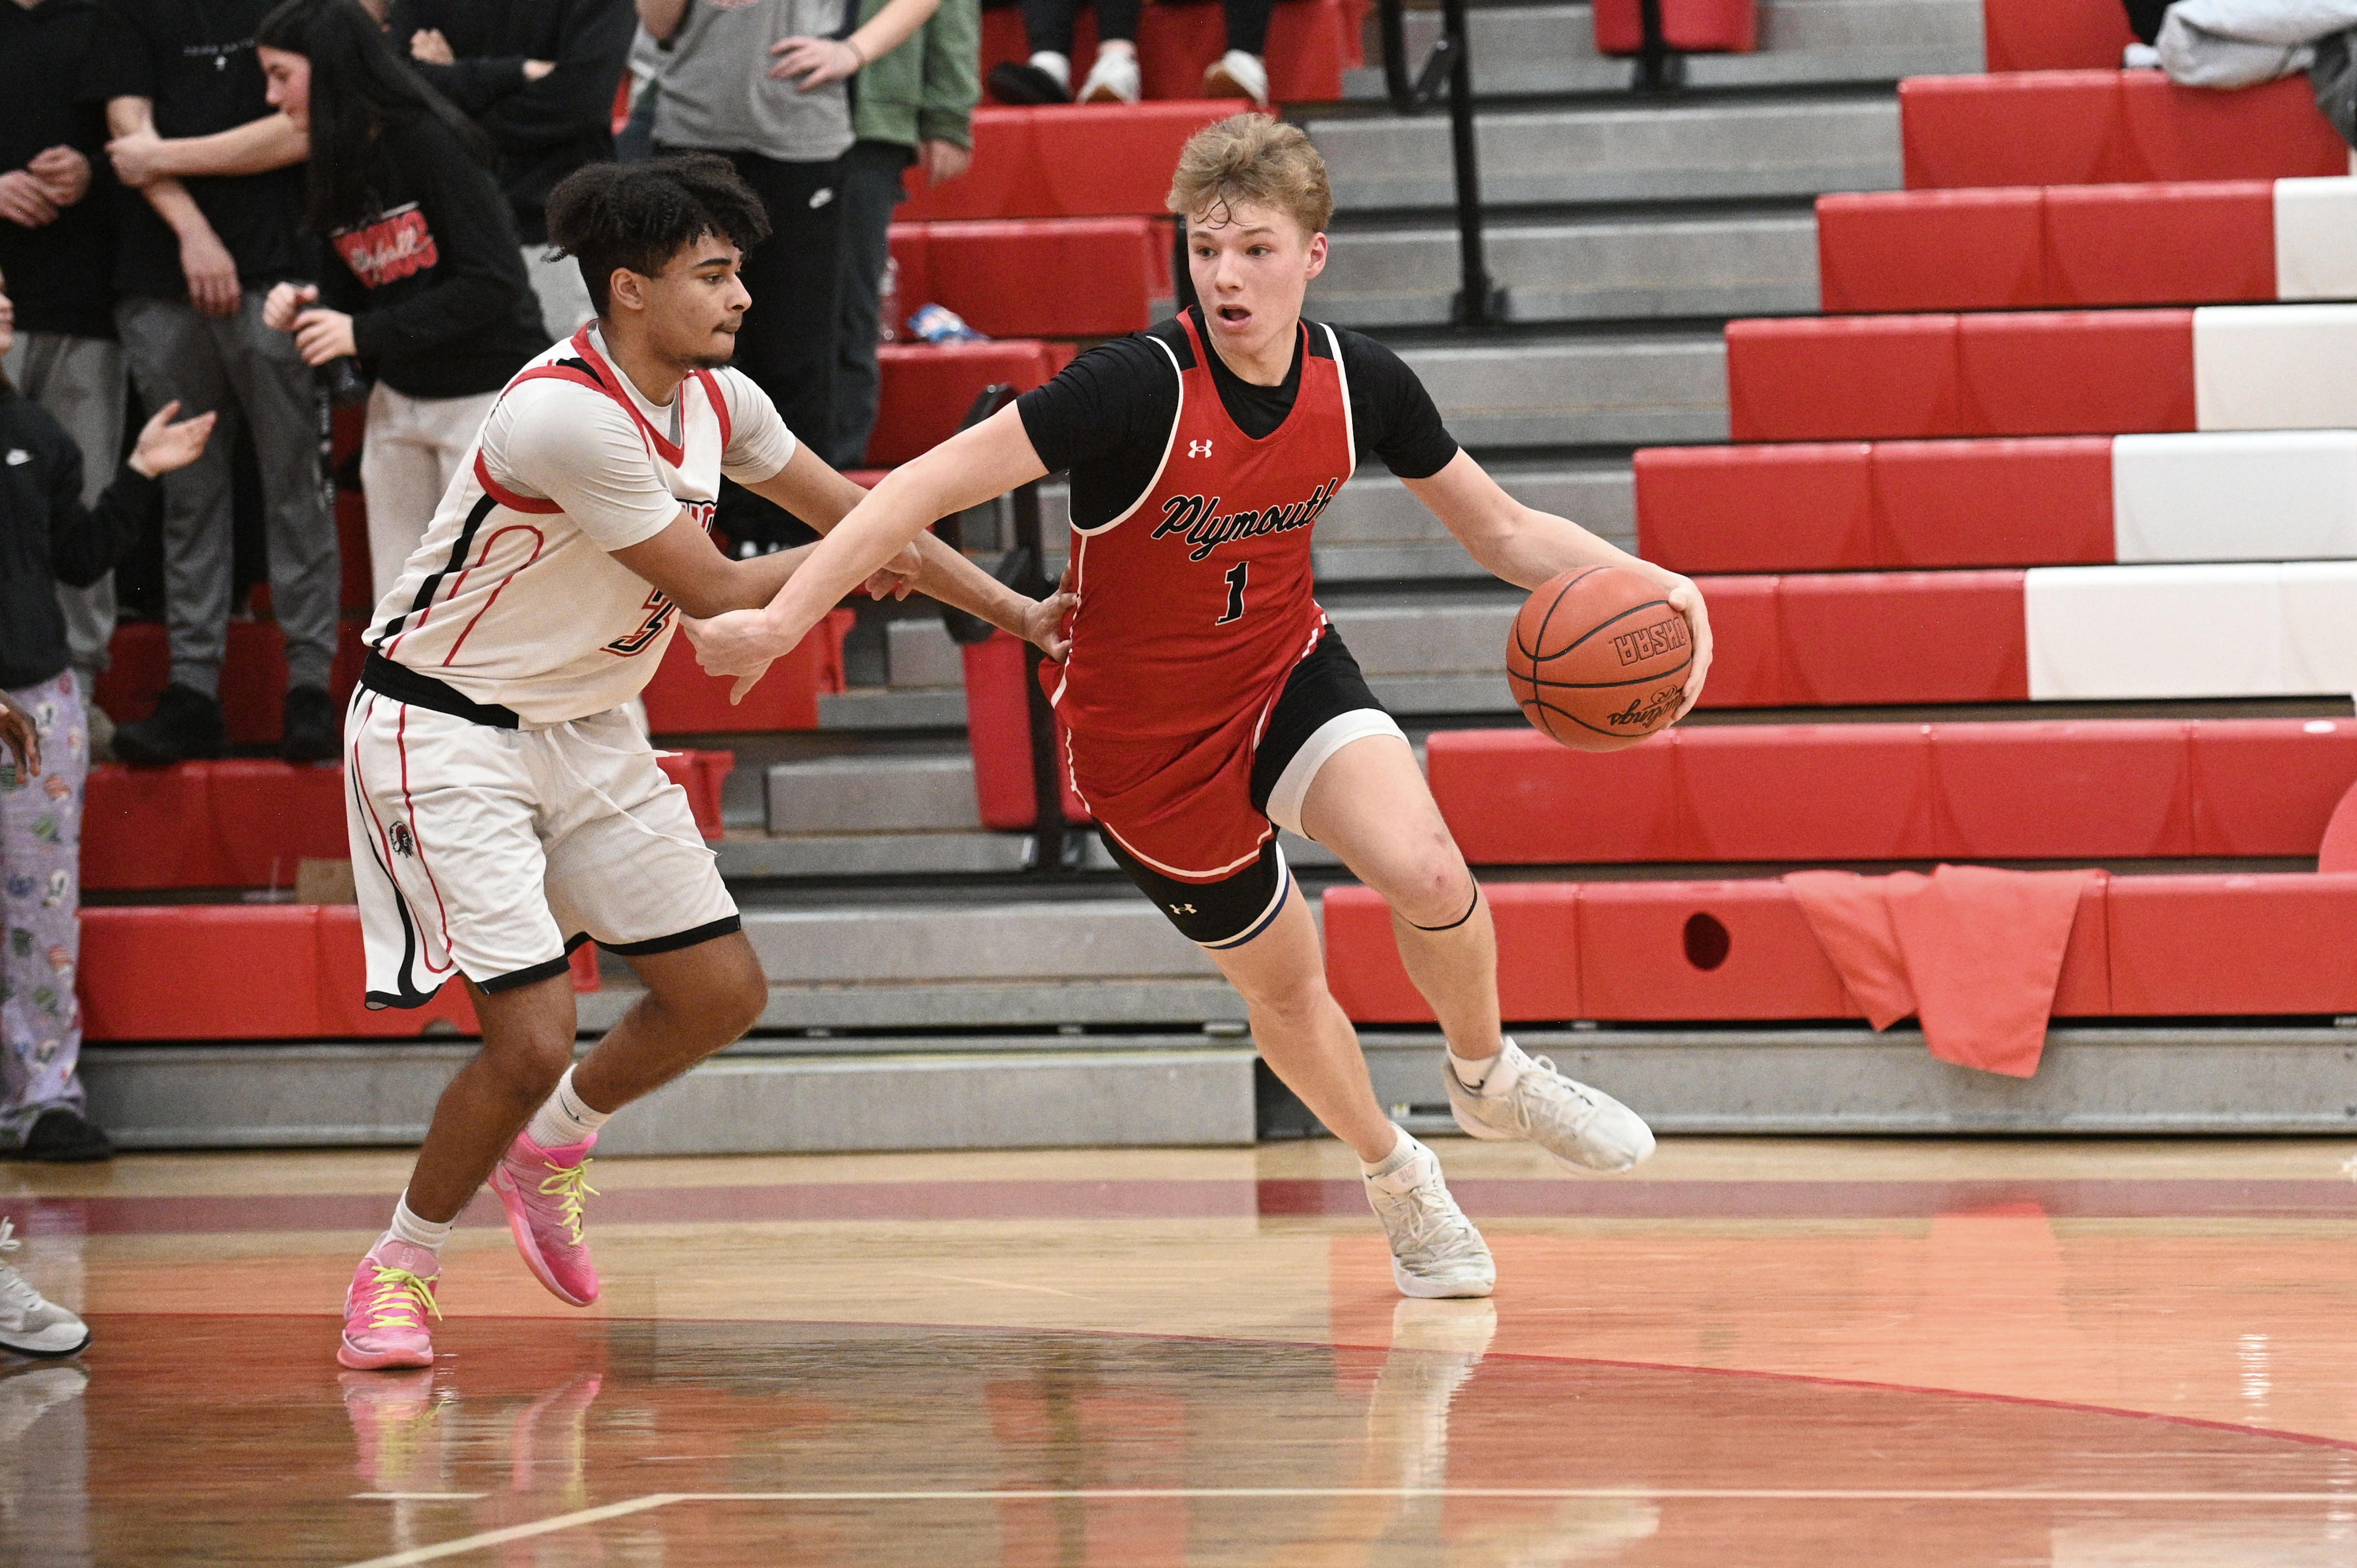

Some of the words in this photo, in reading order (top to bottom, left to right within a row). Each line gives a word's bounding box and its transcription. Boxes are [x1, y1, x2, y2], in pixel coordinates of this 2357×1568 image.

[1151, 477, 1338, 561] Plymouth
[1215, 561, 1249, 626] 1
[1614, 617, 1687, 666] OHSAA
